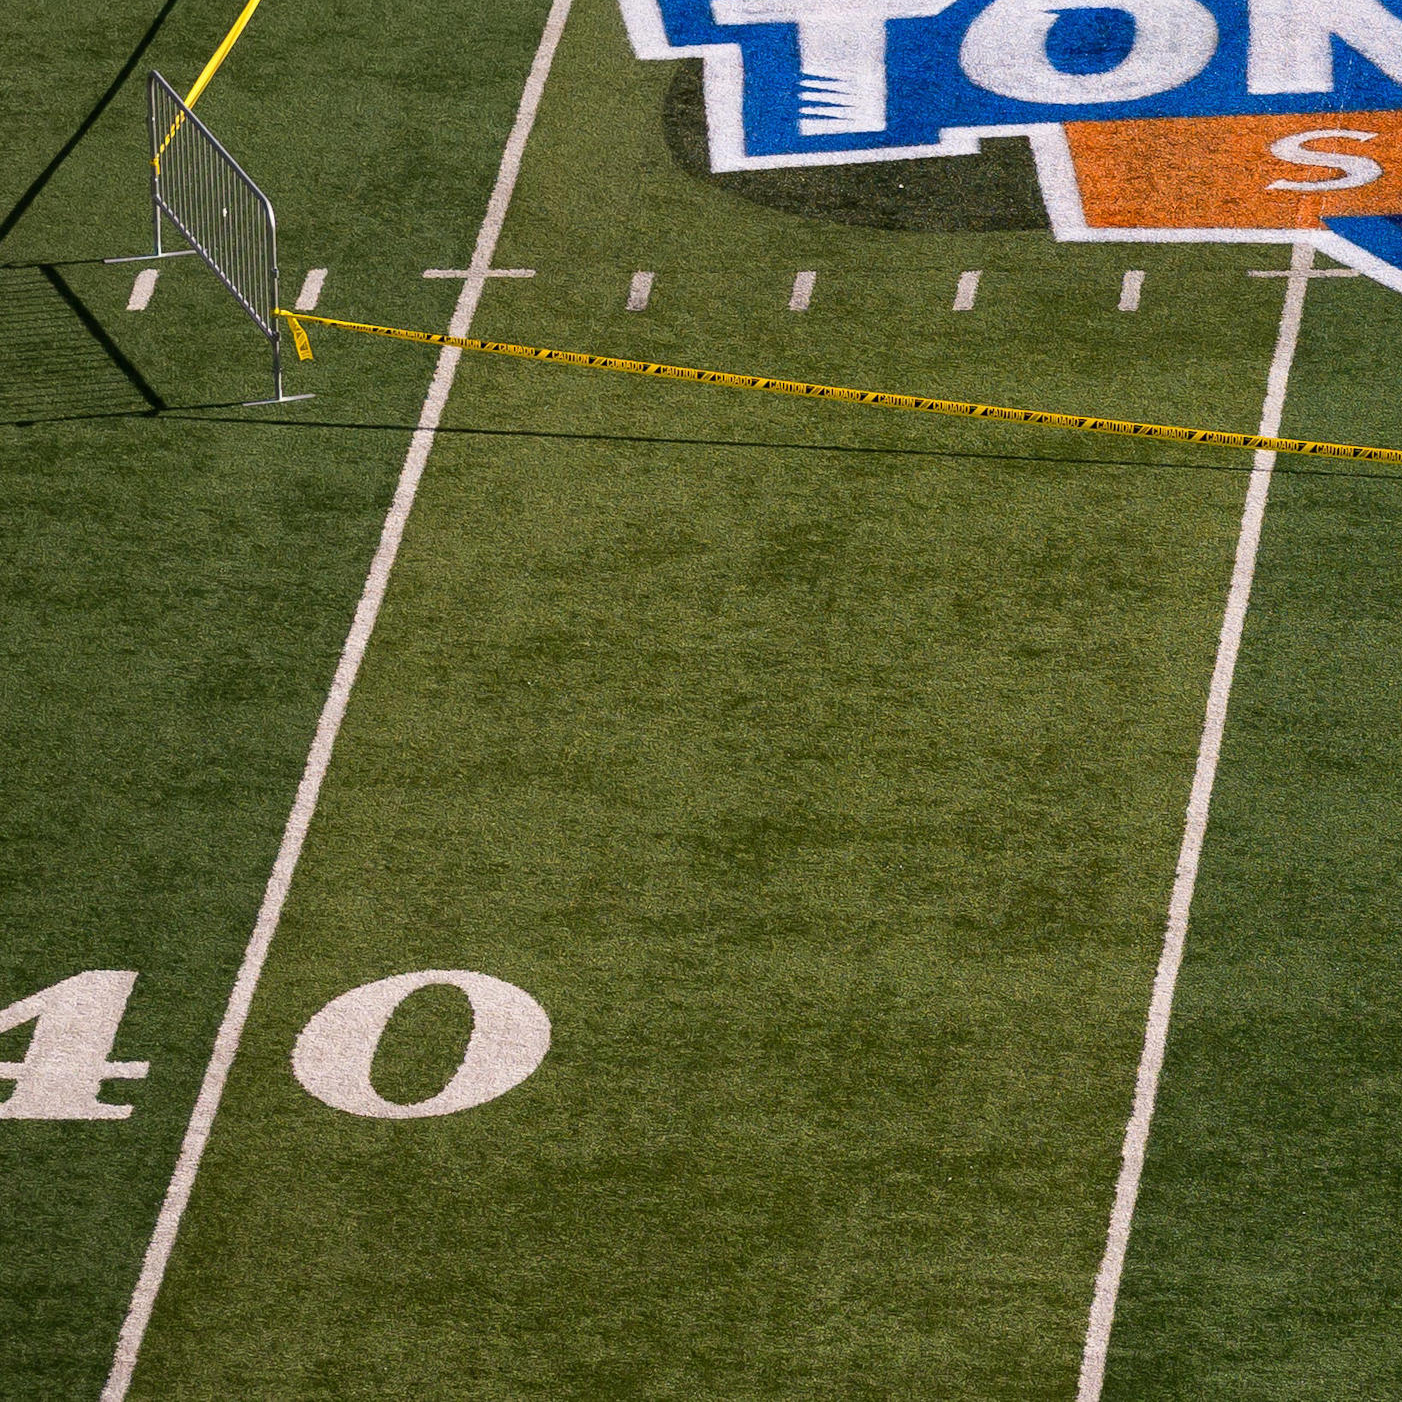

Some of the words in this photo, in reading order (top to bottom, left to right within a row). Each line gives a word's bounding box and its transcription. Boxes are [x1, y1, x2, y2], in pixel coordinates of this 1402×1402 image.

[443, 337, 480, 348] CAUTION
[551, 352, 589, 364] CAUTION
[606, 359, 643, 372] CUIDADO
[660, 367, 697, 379] CAUTION
[714, 374, 752, 387] CUIDADO
[769, 382, 806, 394] CAUTION
[823, 389, 861, 401] CUIDADO
[877, 395, 915, 408] CAUTION
[932, 402, 970, 415] CUIDADO
[986, 408, 1024, 421] CAUTION
[1041, 415, 1080, 427] CUIDADO
[1096, 421, 1134, 434] CAUTION
[1151, 427, 1188, 440] CUIDADO
[1205, 433, 1244, 446] CAUTION
[1261, 439, 1299, 452] CUIDADO
[1316, 444, 1354, 457] CAUTION
